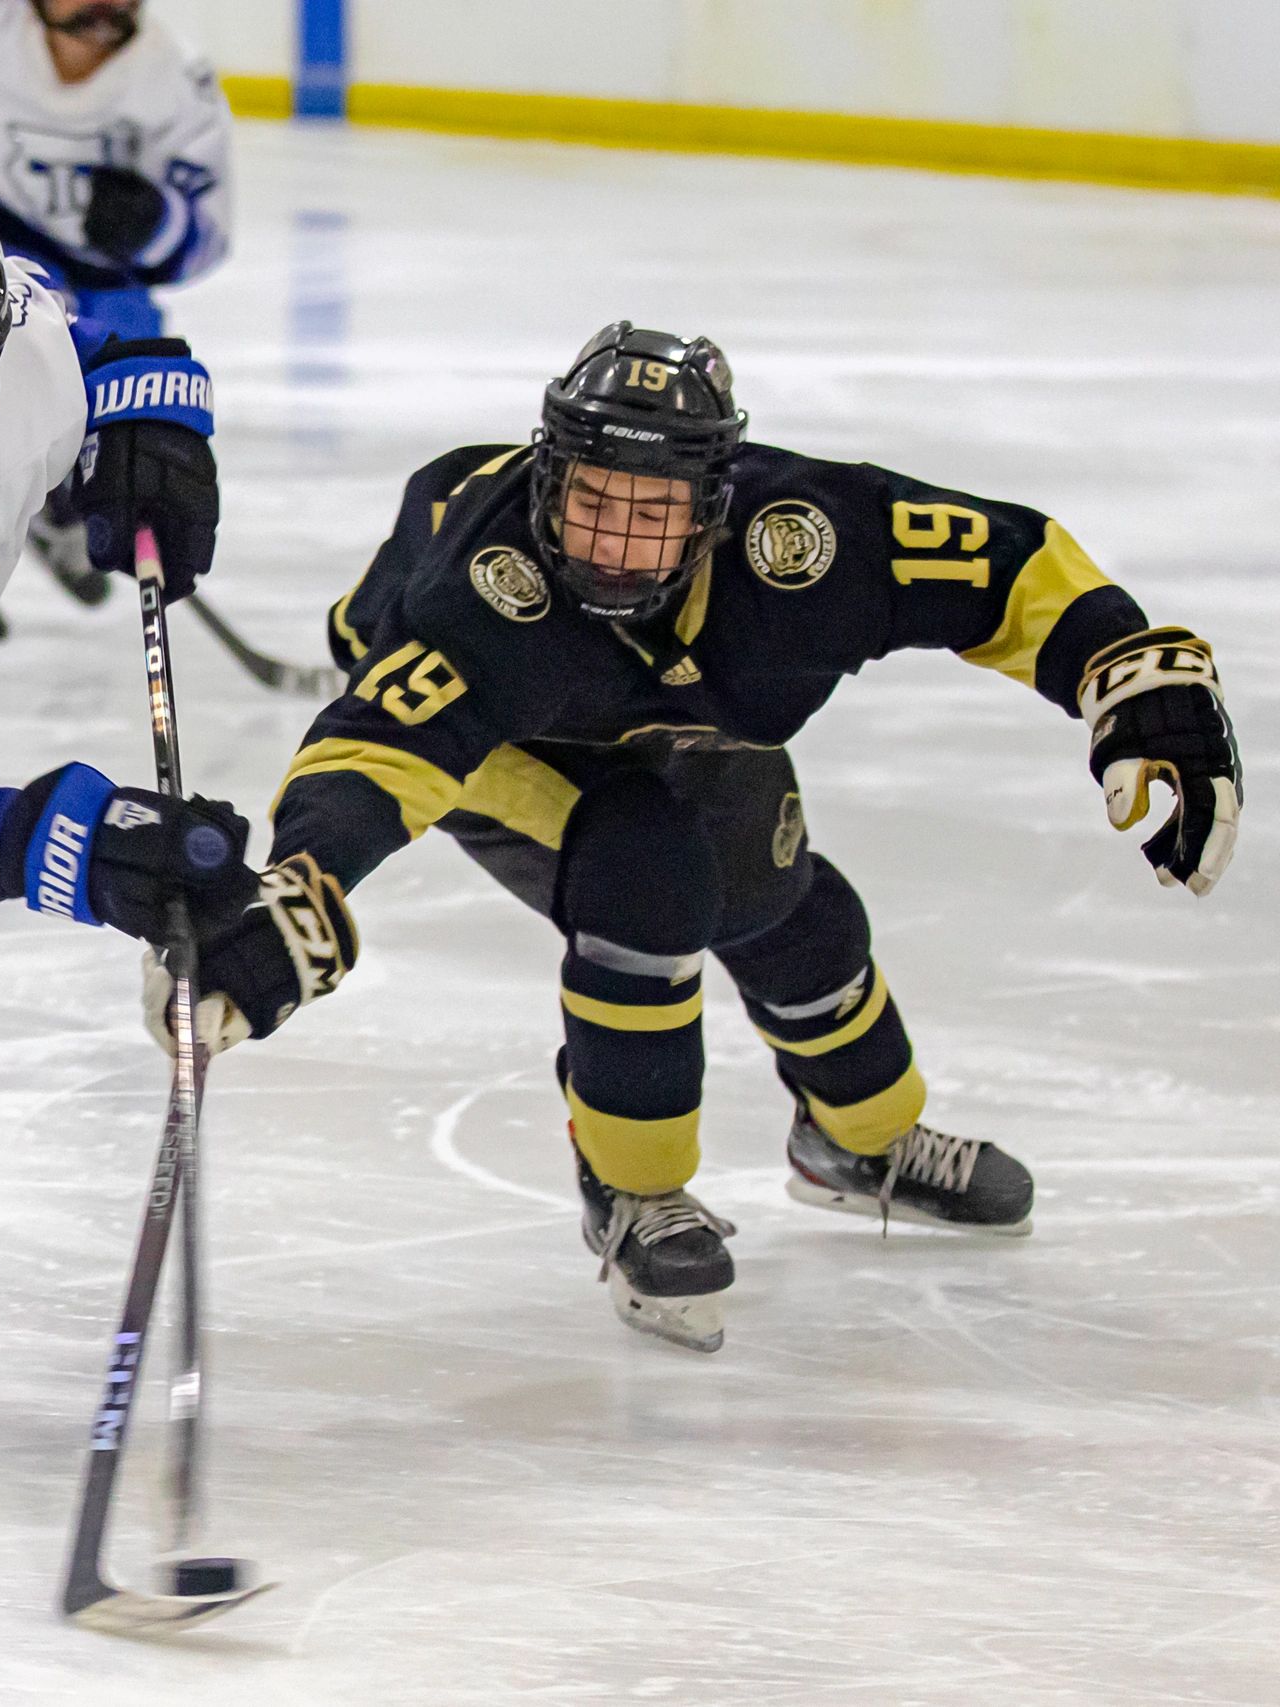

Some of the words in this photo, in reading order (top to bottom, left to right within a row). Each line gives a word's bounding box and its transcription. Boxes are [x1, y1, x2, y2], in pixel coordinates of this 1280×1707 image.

[625, 359, 669, 392] 19
[891, 501, 990, 588] 19
[352, 639, 469, 727] 19
